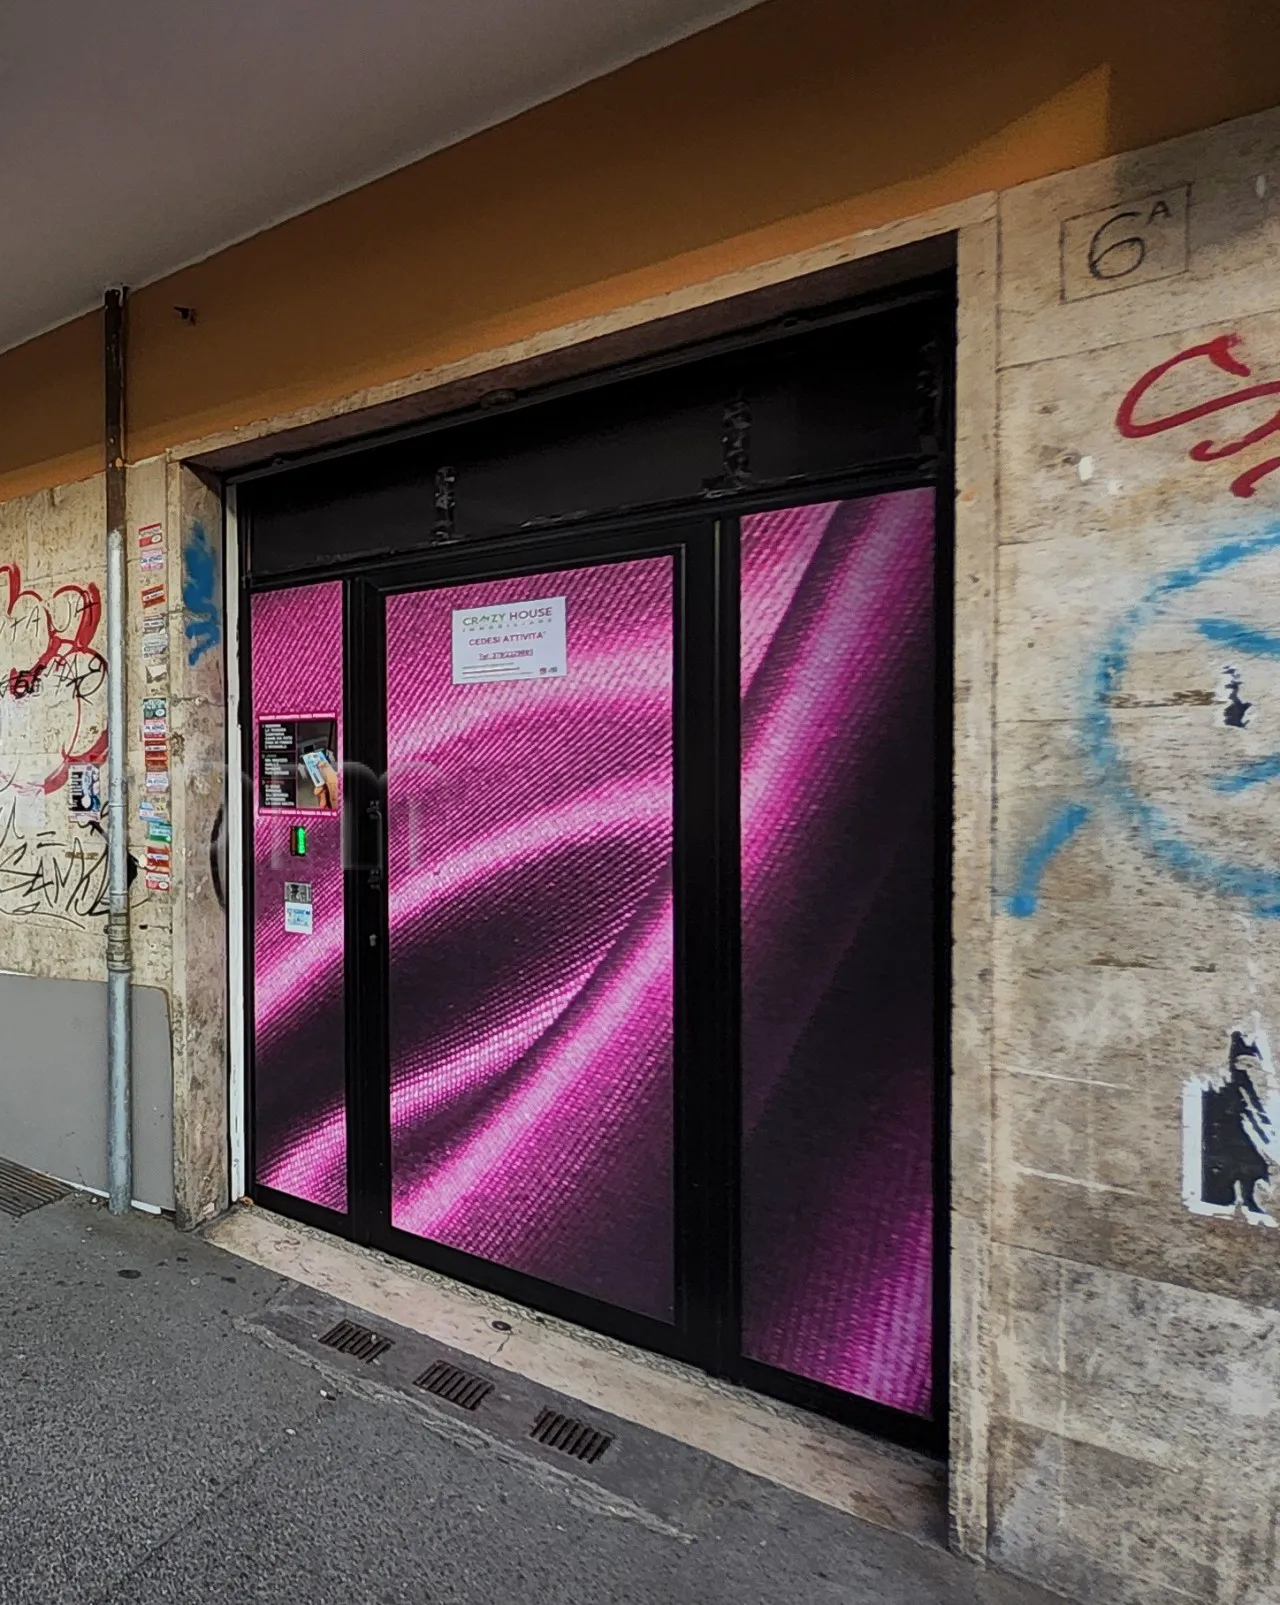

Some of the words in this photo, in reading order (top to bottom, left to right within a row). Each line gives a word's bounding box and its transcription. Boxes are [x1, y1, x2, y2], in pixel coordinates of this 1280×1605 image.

[462, 612, 506, 626] CRAZY
[509, 606, 553, 620] HOUSE
[468, 636, 501, 647] CEDESI
